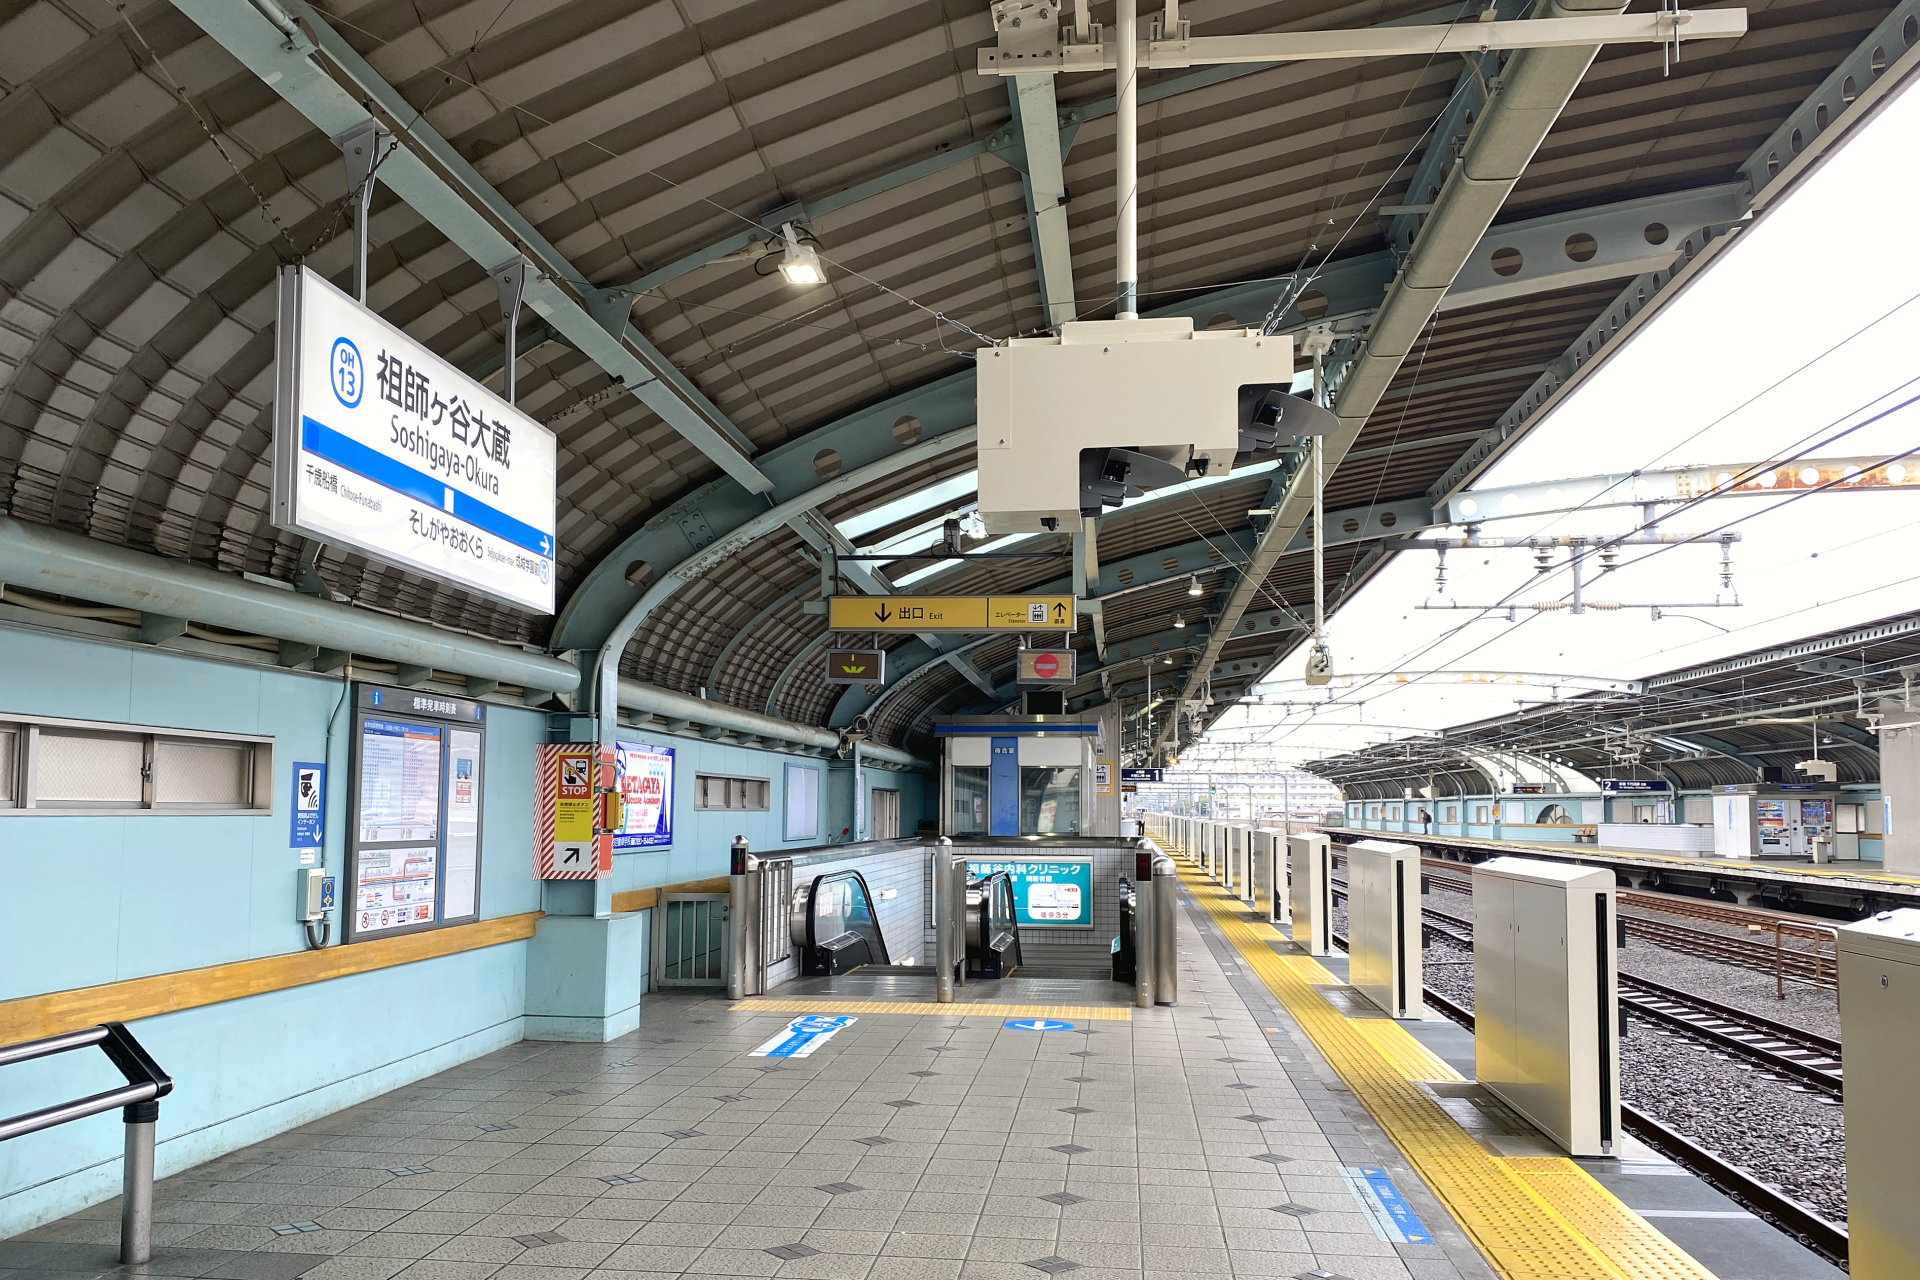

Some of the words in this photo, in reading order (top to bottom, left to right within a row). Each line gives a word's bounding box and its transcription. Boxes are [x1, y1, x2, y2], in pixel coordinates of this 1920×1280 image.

[340, 349, 354, 369] OH
[338, 367, 355, 397] 13
[390, 414, 499, 496] Soshigaya-Okura
[409, 508, 484, 559] そしがやおおくら
[899, 607, 924, 620] 出口
[929, 612, 943, 620] Exit
[1153, 769, 1160, 781] 1
[561, 786, 588, 795] STOP
[1604, 781, 1612, 790] 2
